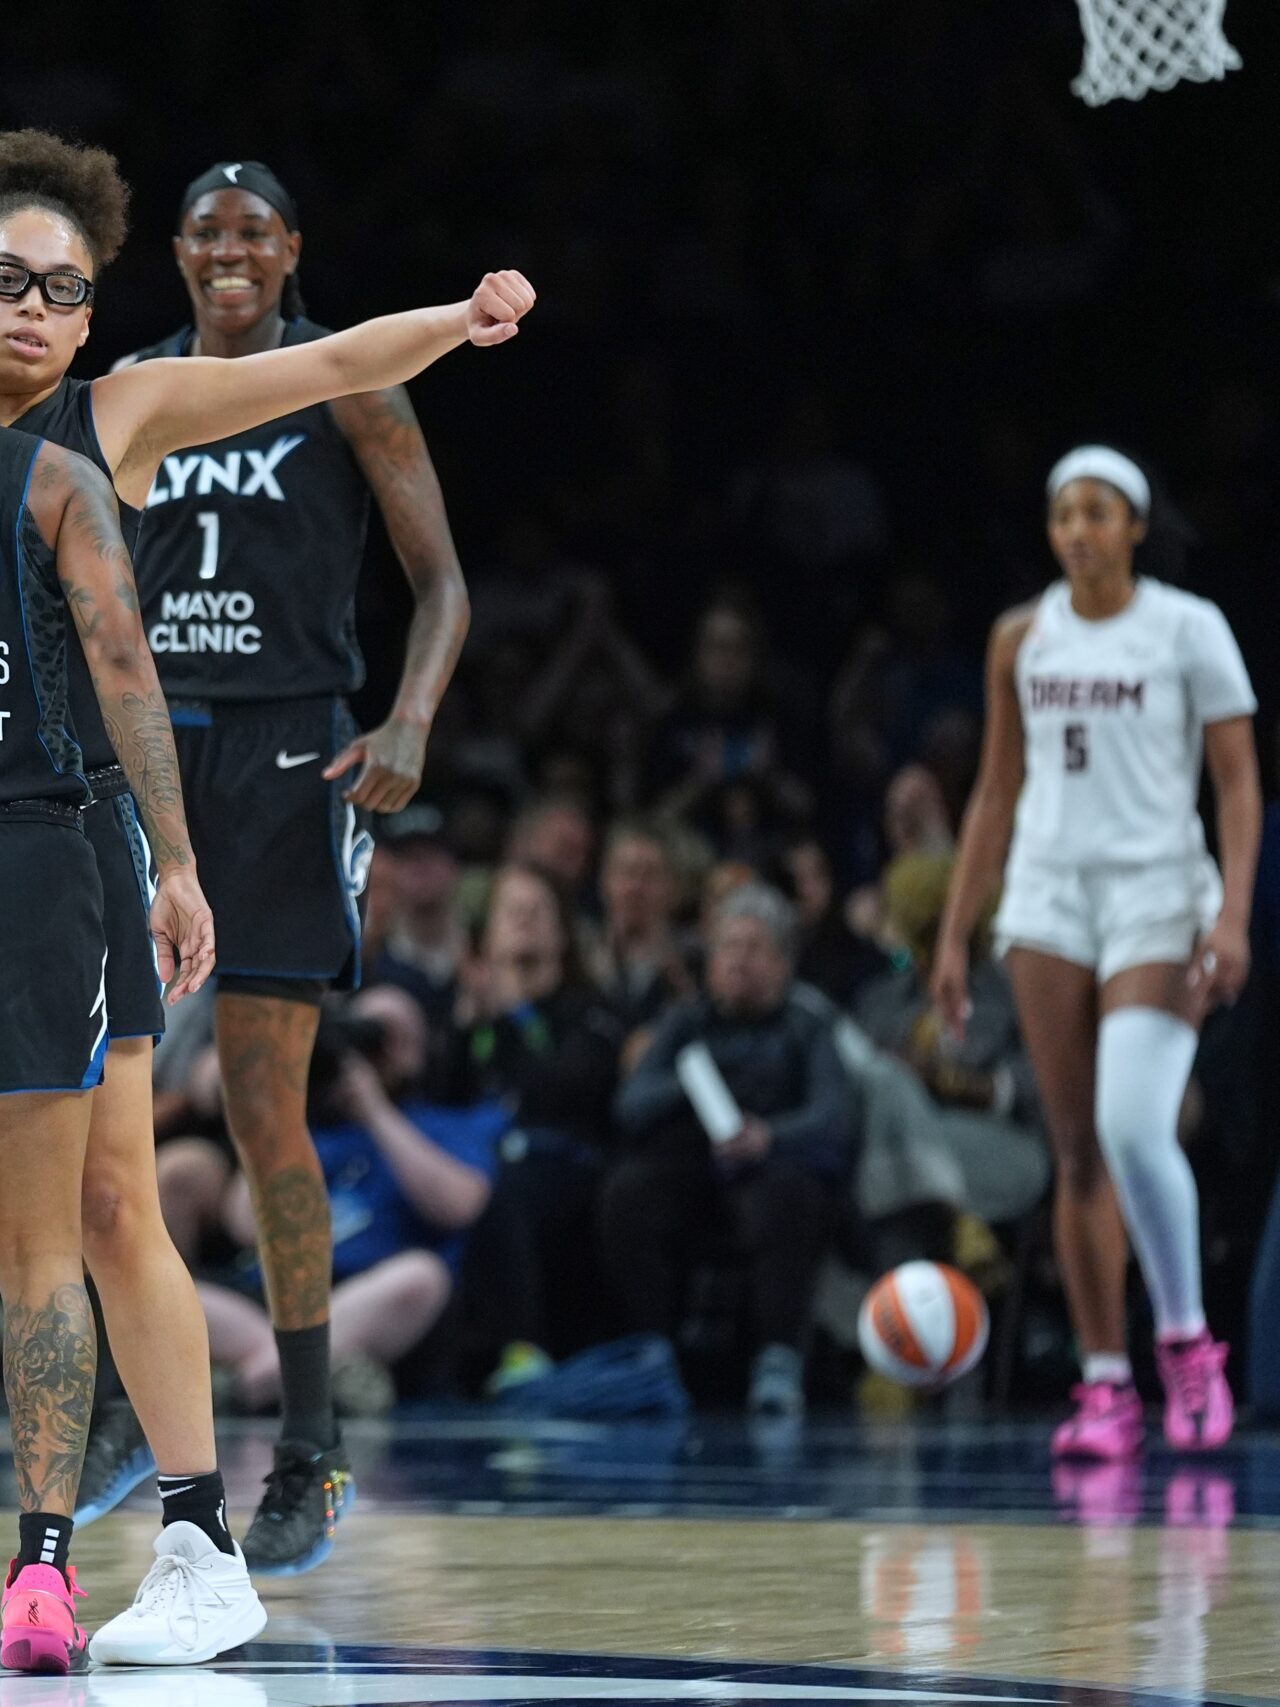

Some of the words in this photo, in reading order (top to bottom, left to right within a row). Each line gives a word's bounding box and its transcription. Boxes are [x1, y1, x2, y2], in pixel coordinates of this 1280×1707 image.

[197, 511, 219, 579] 1
[161, 590, 254, 621] MAYO
[148, 623, 262, 655] CLINIC
[1031, 676, 1144, 709] DREAM
[1064, 723, 1088, 773] 5
